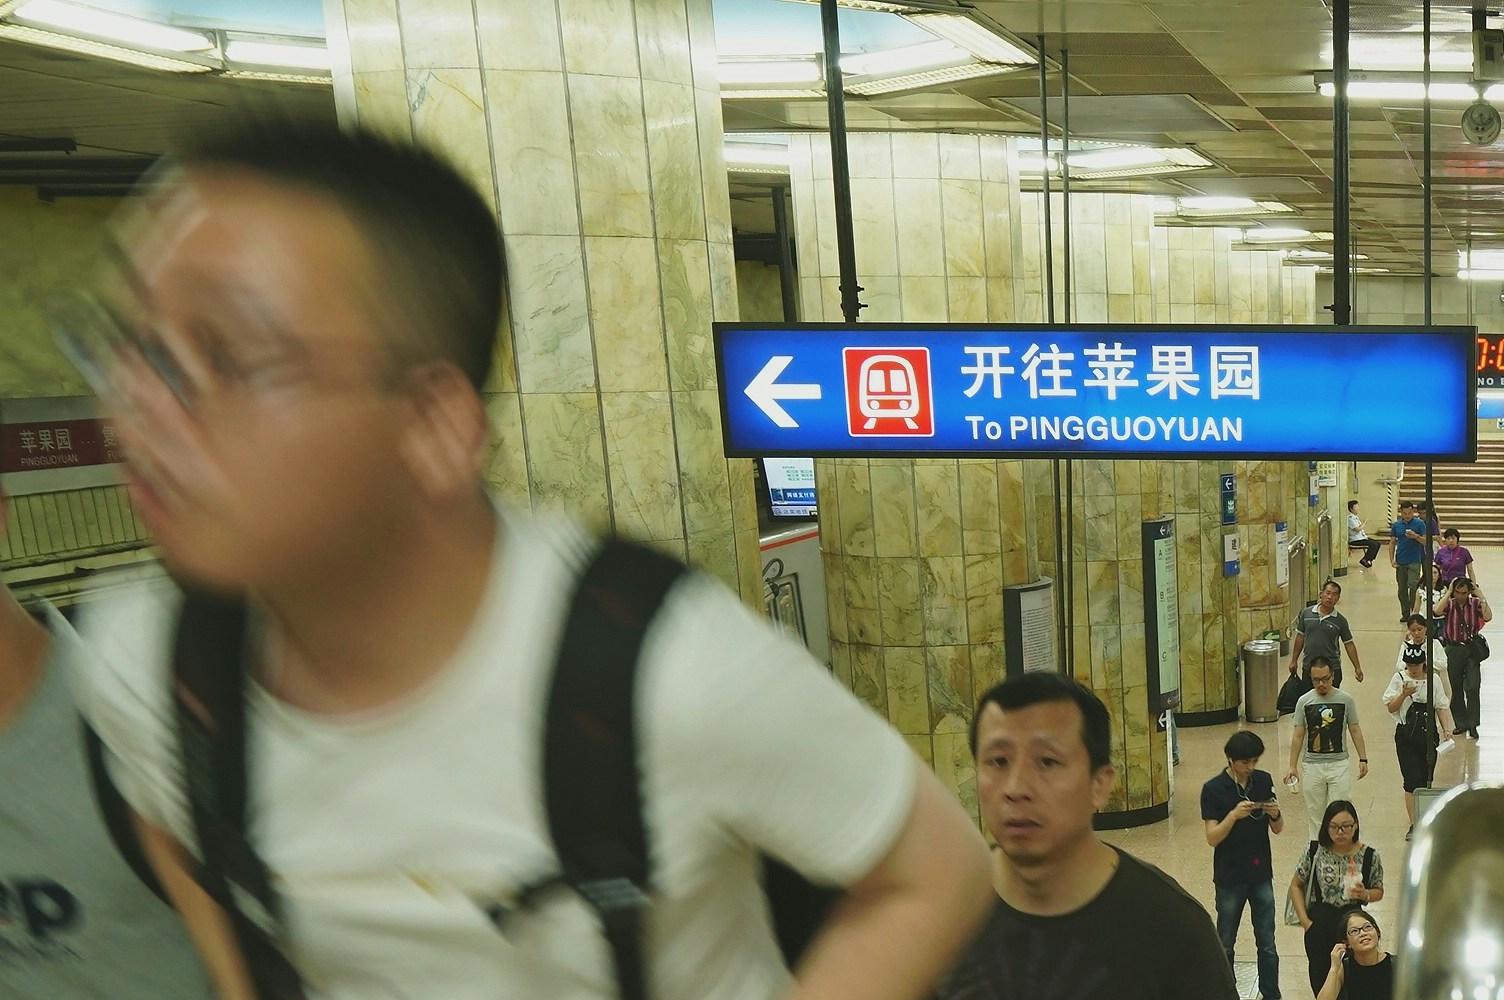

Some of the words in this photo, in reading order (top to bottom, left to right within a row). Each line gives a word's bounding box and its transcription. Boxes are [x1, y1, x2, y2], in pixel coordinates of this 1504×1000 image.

[961, 342, 1260, 400] 开往苹果园
[1477, 378, 1494, 386] NO
[19, 428, 73, 453] 苹果园
[965, 416, 1001, 440] To
[1010, 415, 1243, 441] PINGGUOYUAN
